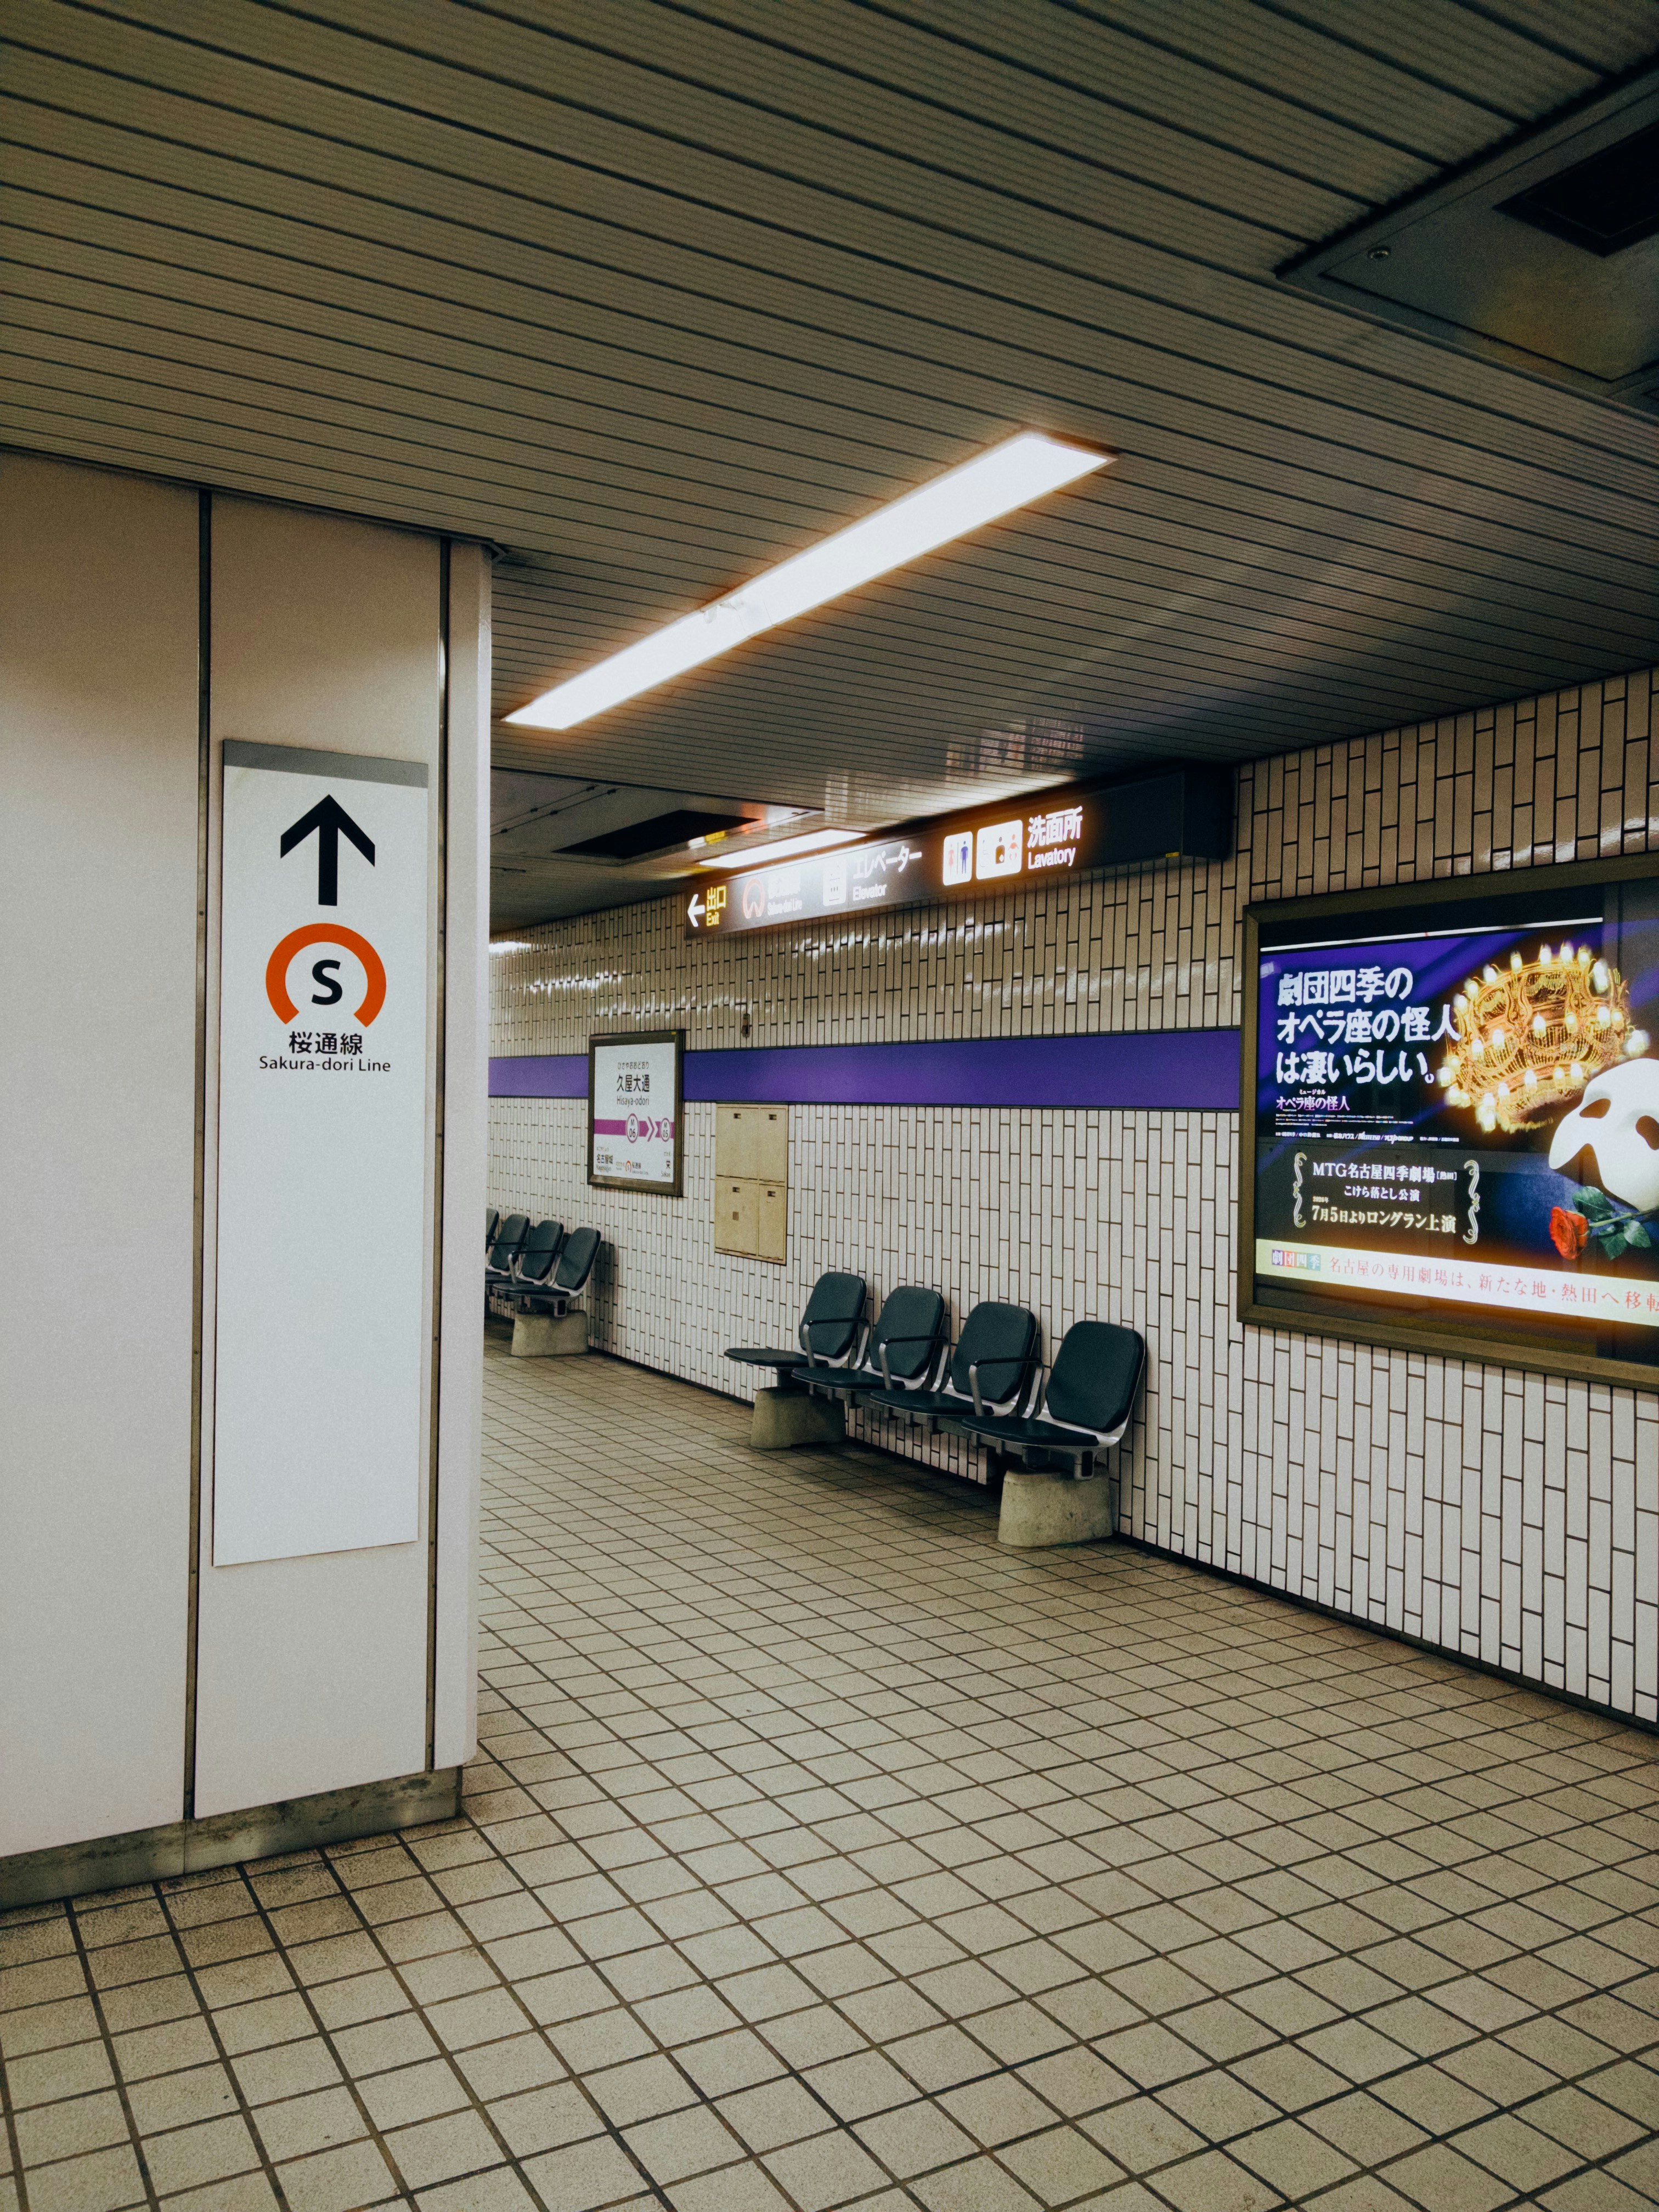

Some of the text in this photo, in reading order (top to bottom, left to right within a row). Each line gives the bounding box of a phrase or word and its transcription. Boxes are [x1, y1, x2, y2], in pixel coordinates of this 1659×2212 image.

[1027, 806, 1083, 848] 洗面所
[853, 845, 922, 879] エレベーター
[1028, 847, 1076, 870] Lavatory
[706, 885, 727, 912] 出口
[853, 883, 887, 901] Elevator
[706, 912, 720, 926] Exit
[312, 959, 343, 1005] S
[1278, 966, 1413, 1006] 劇団四季の
[1277, 1005, 1462, 1045] オペラ座の怪人
[289, 1031, 363, 1055] 桜通線
[259, 1056, 391, 1071] Sakura-dori Line
[1276, 1049, 1436, 1085] は凄いらしい。
[617, 1074, 650, 1092] 久屋大通
[617, 1096, 650, 1108] Hisaya-odori
[1276, 1096, 1350, 1111] オペラ座の怪人
[629, 1128, 636, 1137] 06
[663, 1130, 669, 1138] 05
[1344, 1186, 1420, 1202] こけら落とし公演
[1312, 1206, 1457, 1234] 7月5日よりロングラン上演
[1272, 1250, 1320, 1270] 劇団四季
